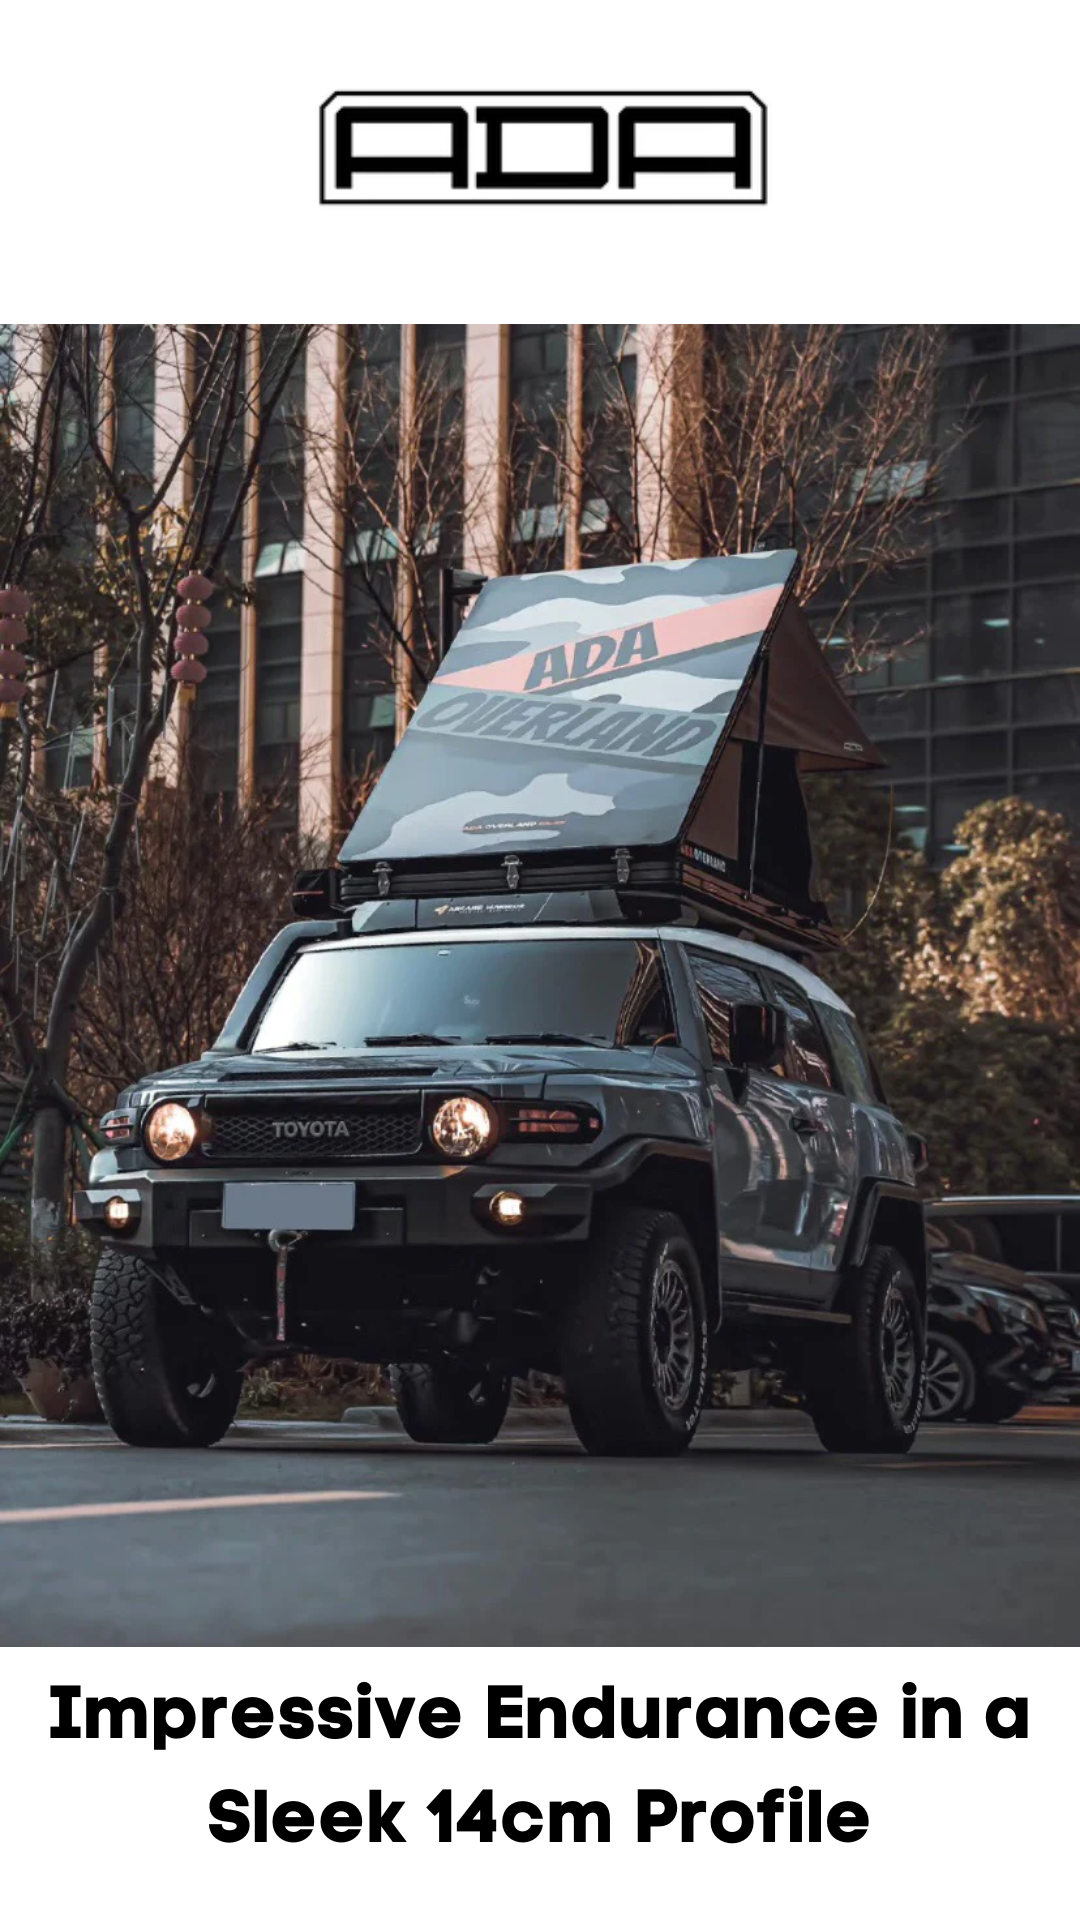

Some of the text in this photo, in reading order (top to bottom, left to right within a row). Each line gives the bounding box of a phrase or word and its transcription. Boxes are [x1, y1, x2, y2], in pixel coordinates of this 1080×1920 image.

[523, 622, 659, 690] ADA
[417, 692, 716, 756] OVERLAND
[272, 1120, 350, 1138] TOYOTA
